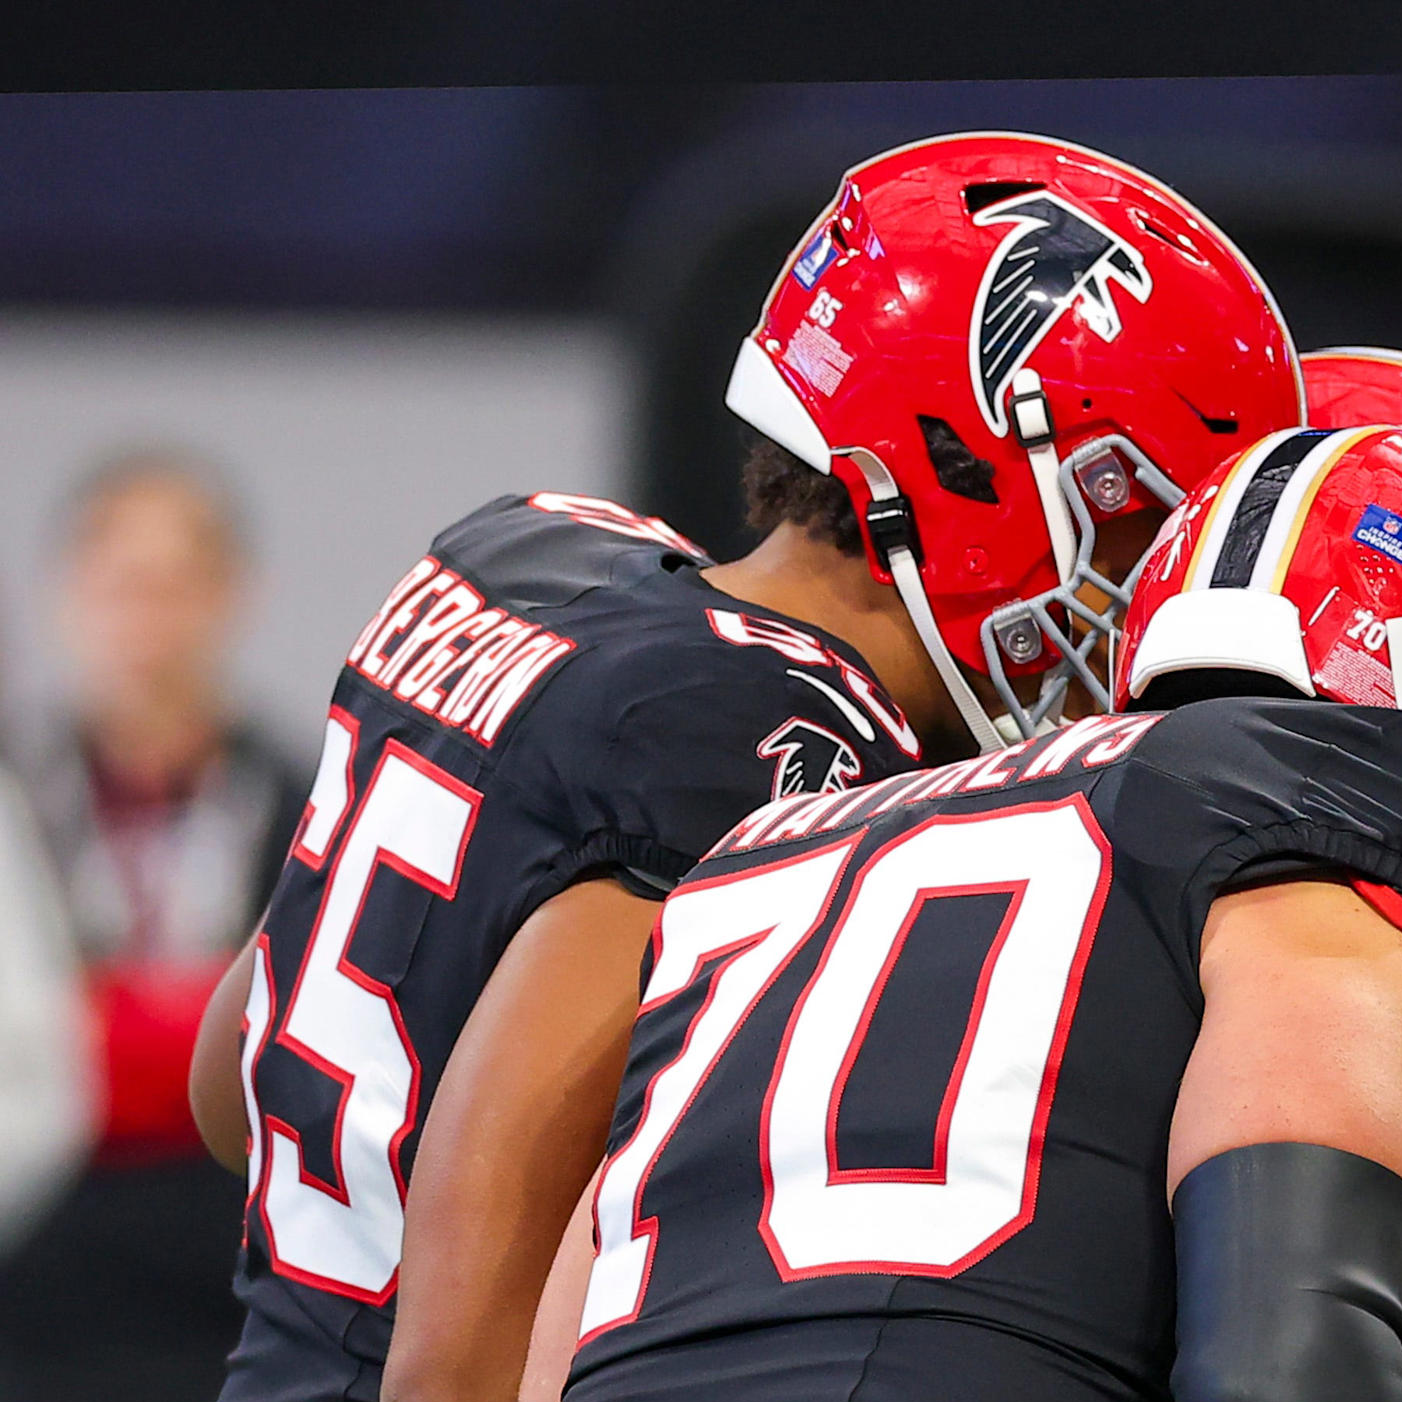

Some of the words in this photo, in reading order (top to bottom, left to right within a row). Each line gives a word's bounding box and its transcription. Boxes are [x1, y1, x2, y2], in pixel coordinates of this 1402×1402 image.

[807, 290, 844, 329] 65
[1346, 609, 1387, 652] 70
[575, 791, 1113, 1352] 70
